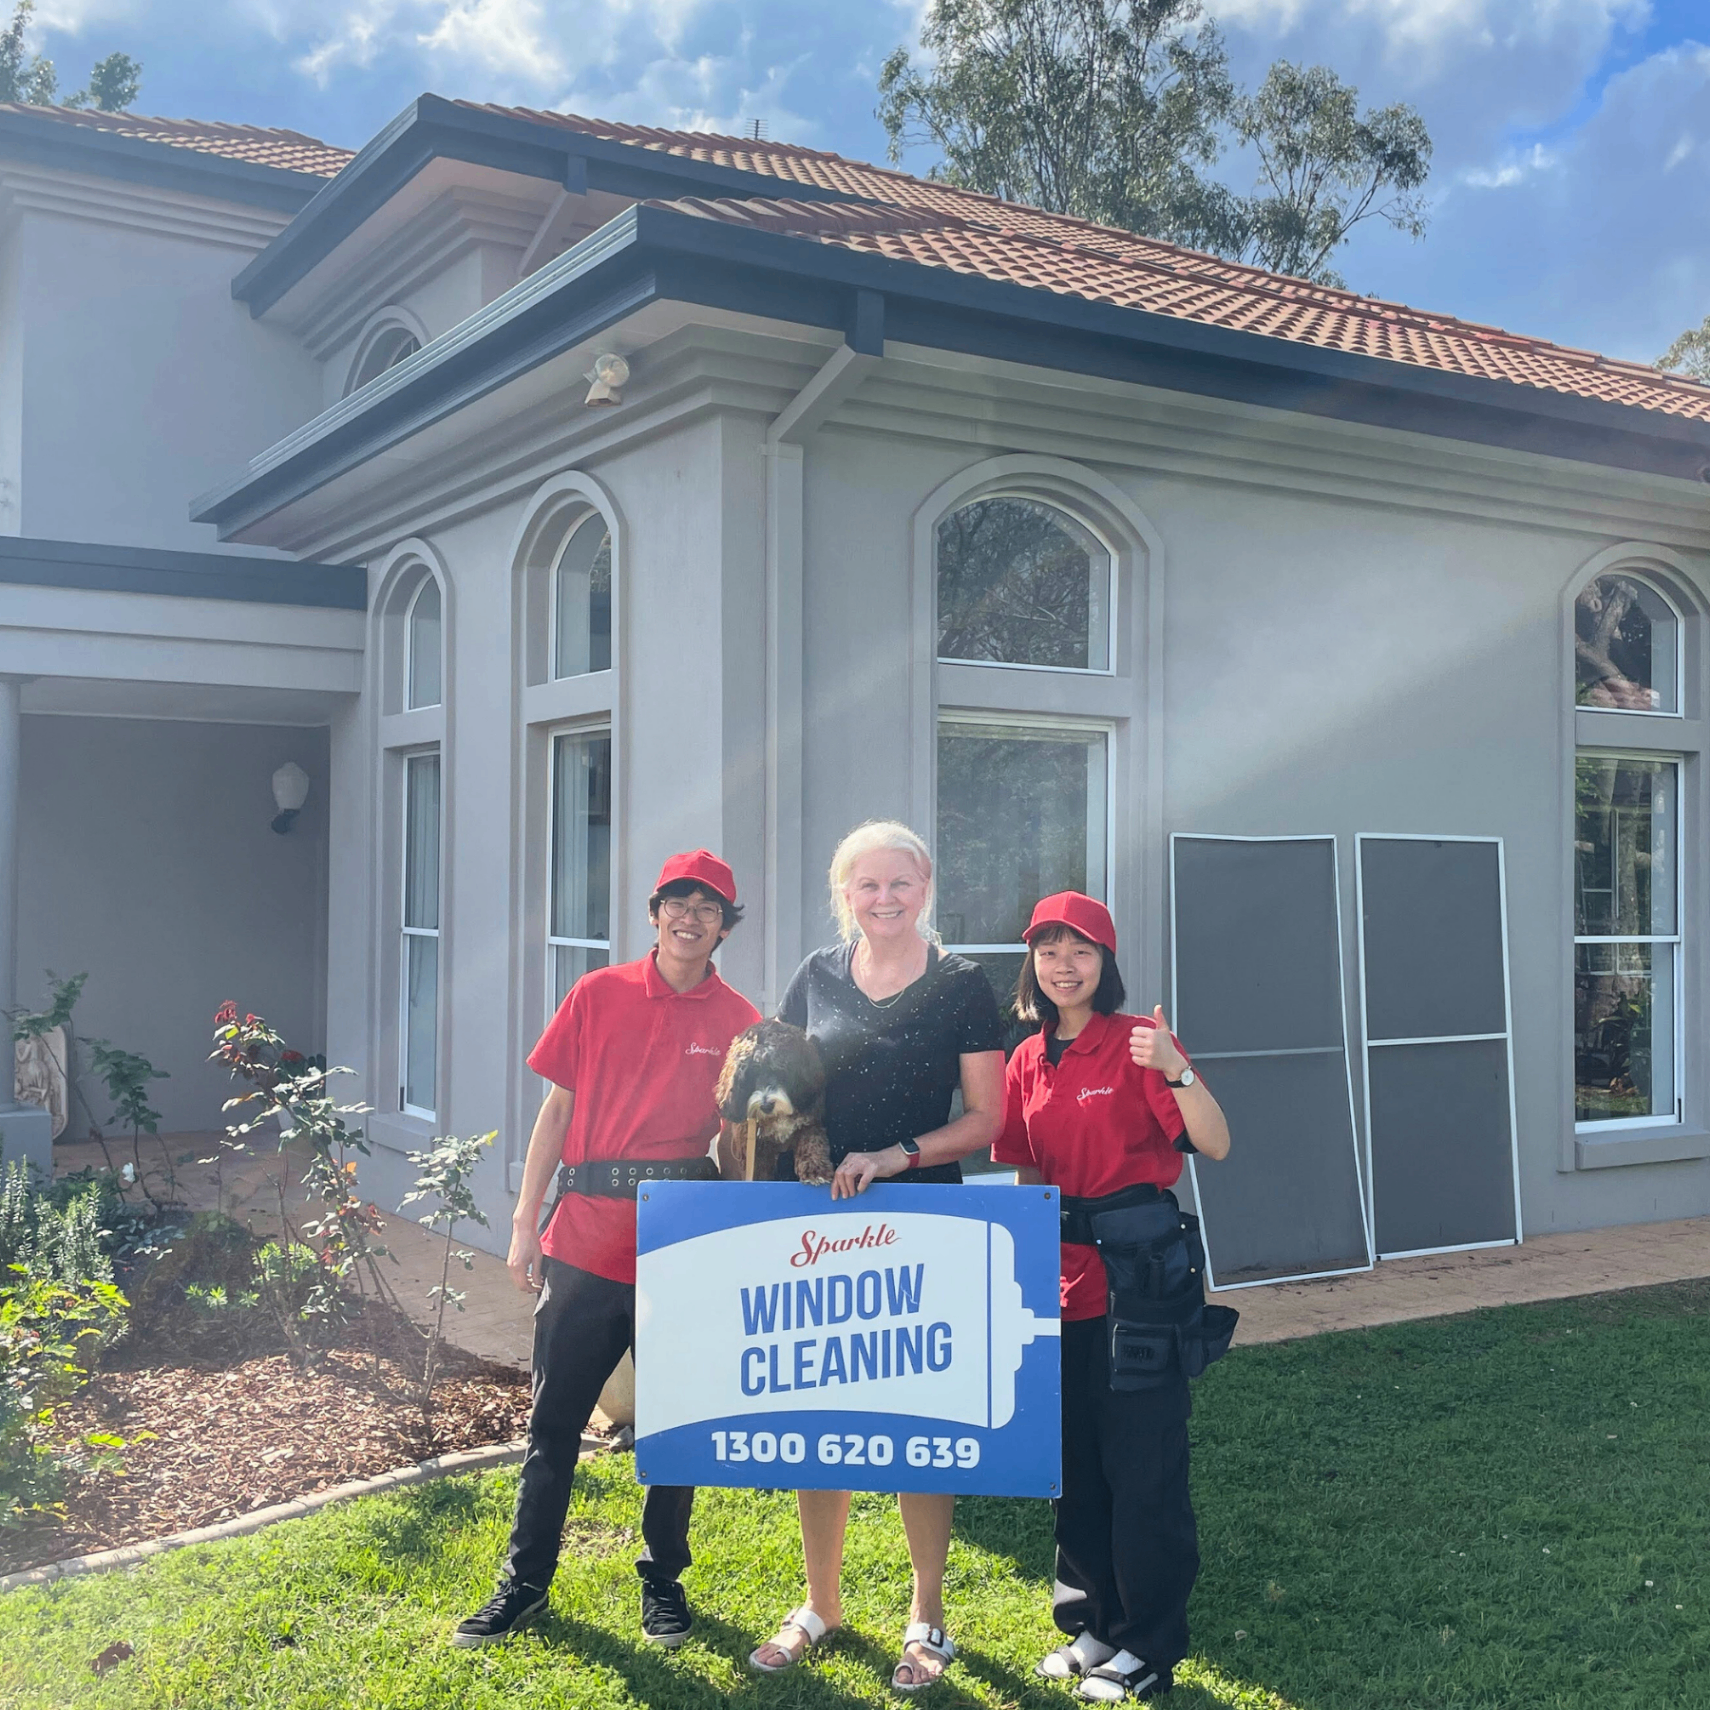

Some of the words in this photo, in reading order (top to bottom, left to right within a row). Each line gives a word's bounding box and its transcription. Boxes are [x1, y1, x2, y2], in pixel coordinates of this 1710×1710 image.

[790, 1223, 901, 1267] Sparkle
[740, 1263, 924, 1336] WINDOW
[740, 1321, 952, 1397] CLEANING
[711, 1431, 806, 1464] 1300
[817, 1433, 894, 1466] 620
[906, 1436, 981, 1469] 639
